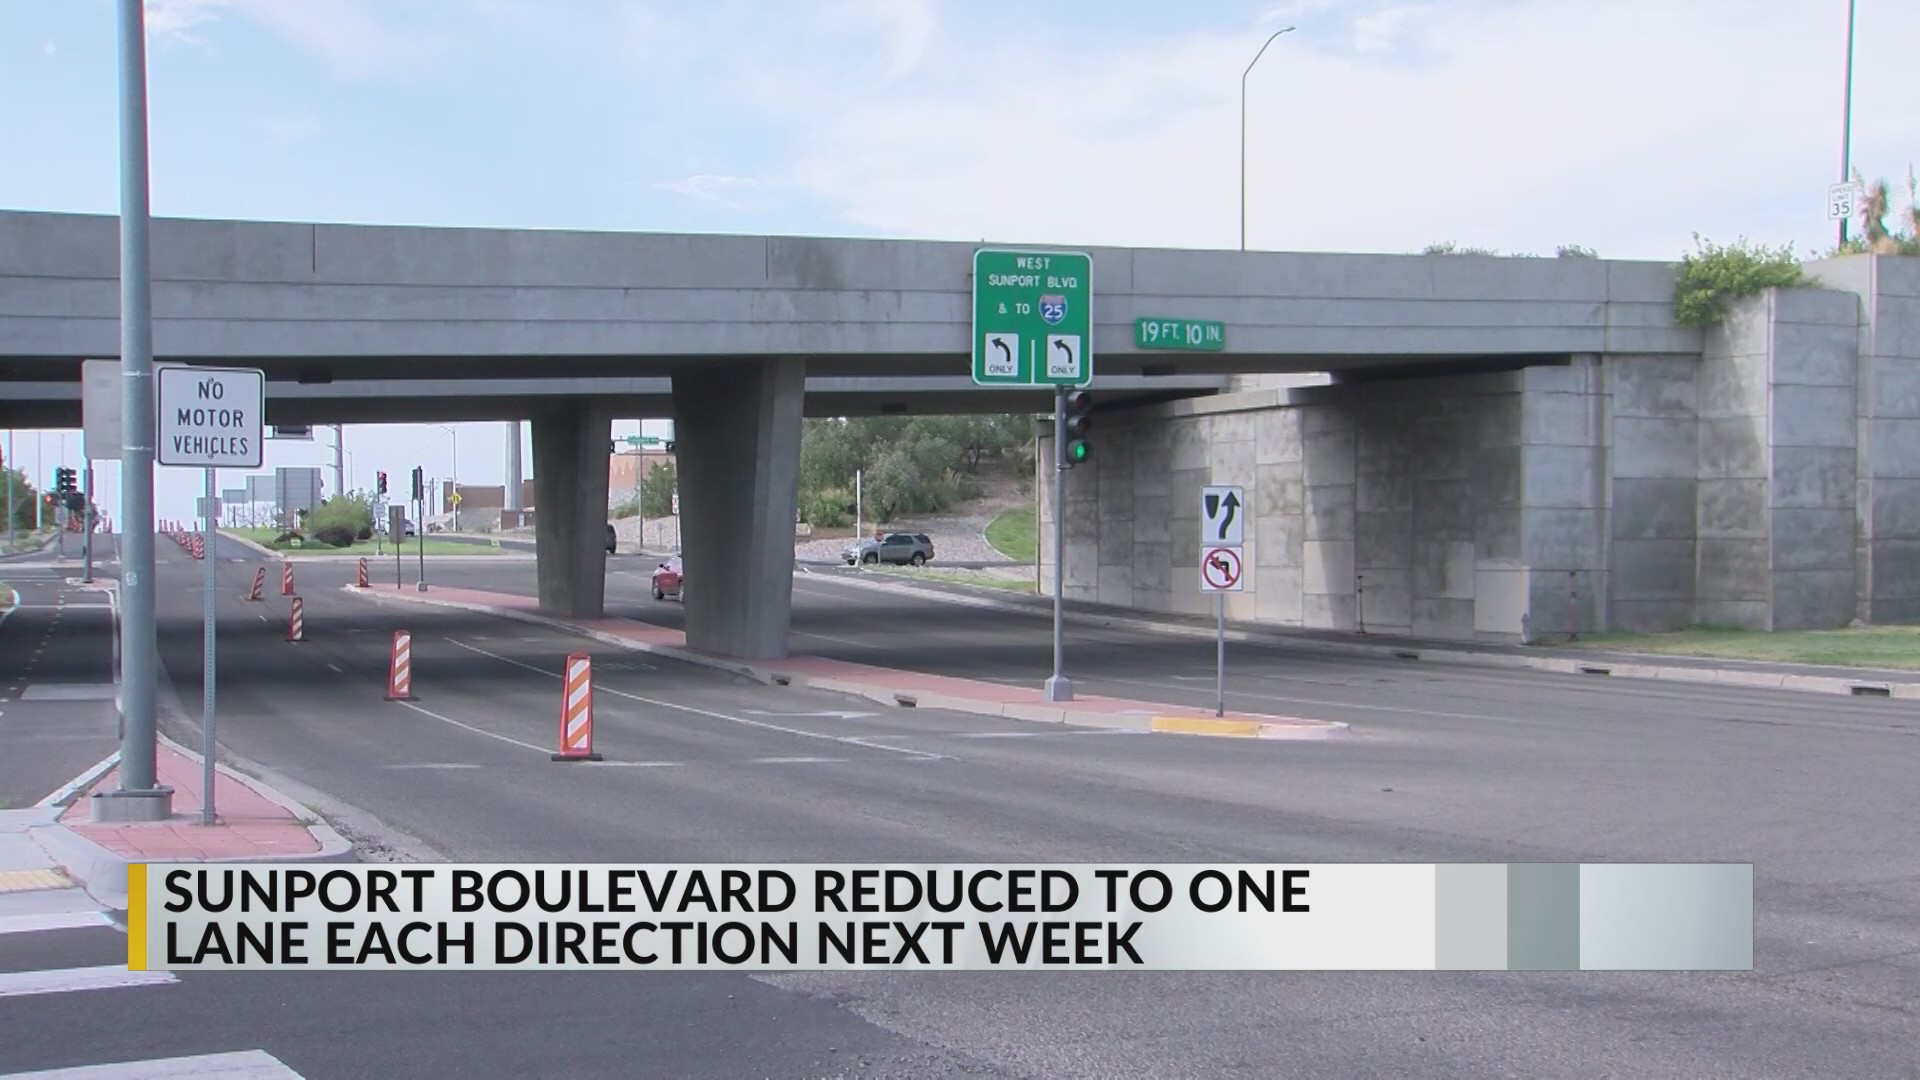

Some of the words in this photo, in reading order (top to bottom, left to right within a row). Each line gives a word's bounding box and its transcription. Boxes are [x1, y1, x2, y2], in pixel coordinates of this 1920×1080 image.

[1832, 201, 1849, 216] 35
[1016, 257, 1050, 270] WEST
[988, 273, 1040, 287] SUNPORT
[998, 302, 1007, 314] &
[1015, 303, 1031, 315] TO
[1044, 304, 1064, 319] 25
[1141, 321, 1159, 343] 19
[1185, 324, 1203, 345] 10
[988, 364, 1014, 375] ONLY
[1051, 365, 1076, 375] ONLY
[198, 381, 223, 399] NO
[177, 408, 243, 427] MOTOR
[173, 436, 248, 456] VEHICLES
